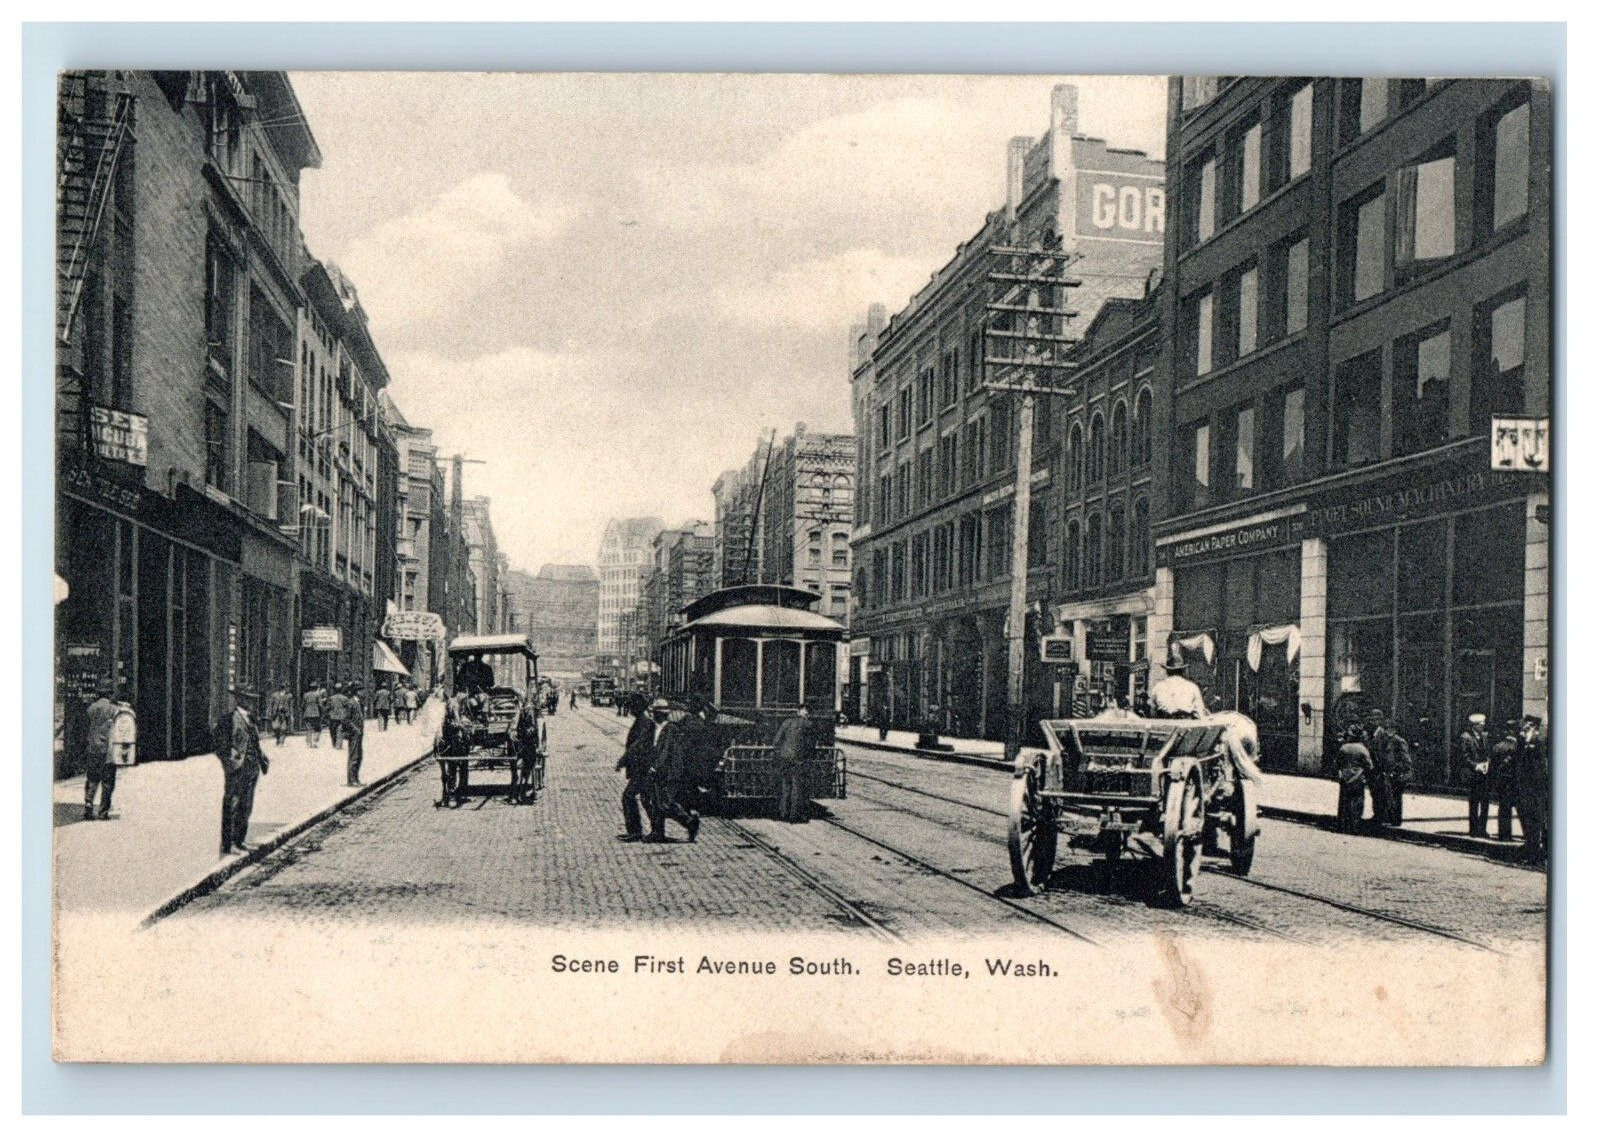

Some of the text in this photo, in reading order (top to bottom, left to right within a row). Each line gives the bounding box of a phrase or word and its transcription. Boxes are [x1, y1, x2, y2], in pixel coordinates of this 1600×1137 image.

[1092, 183, 1165, 232] GOR
[1174, 540, 1210, 558] AMERICAN
[1211, 534, 1236, 550] PAPER
[1238, 525, 1278, 545] COMPANY
